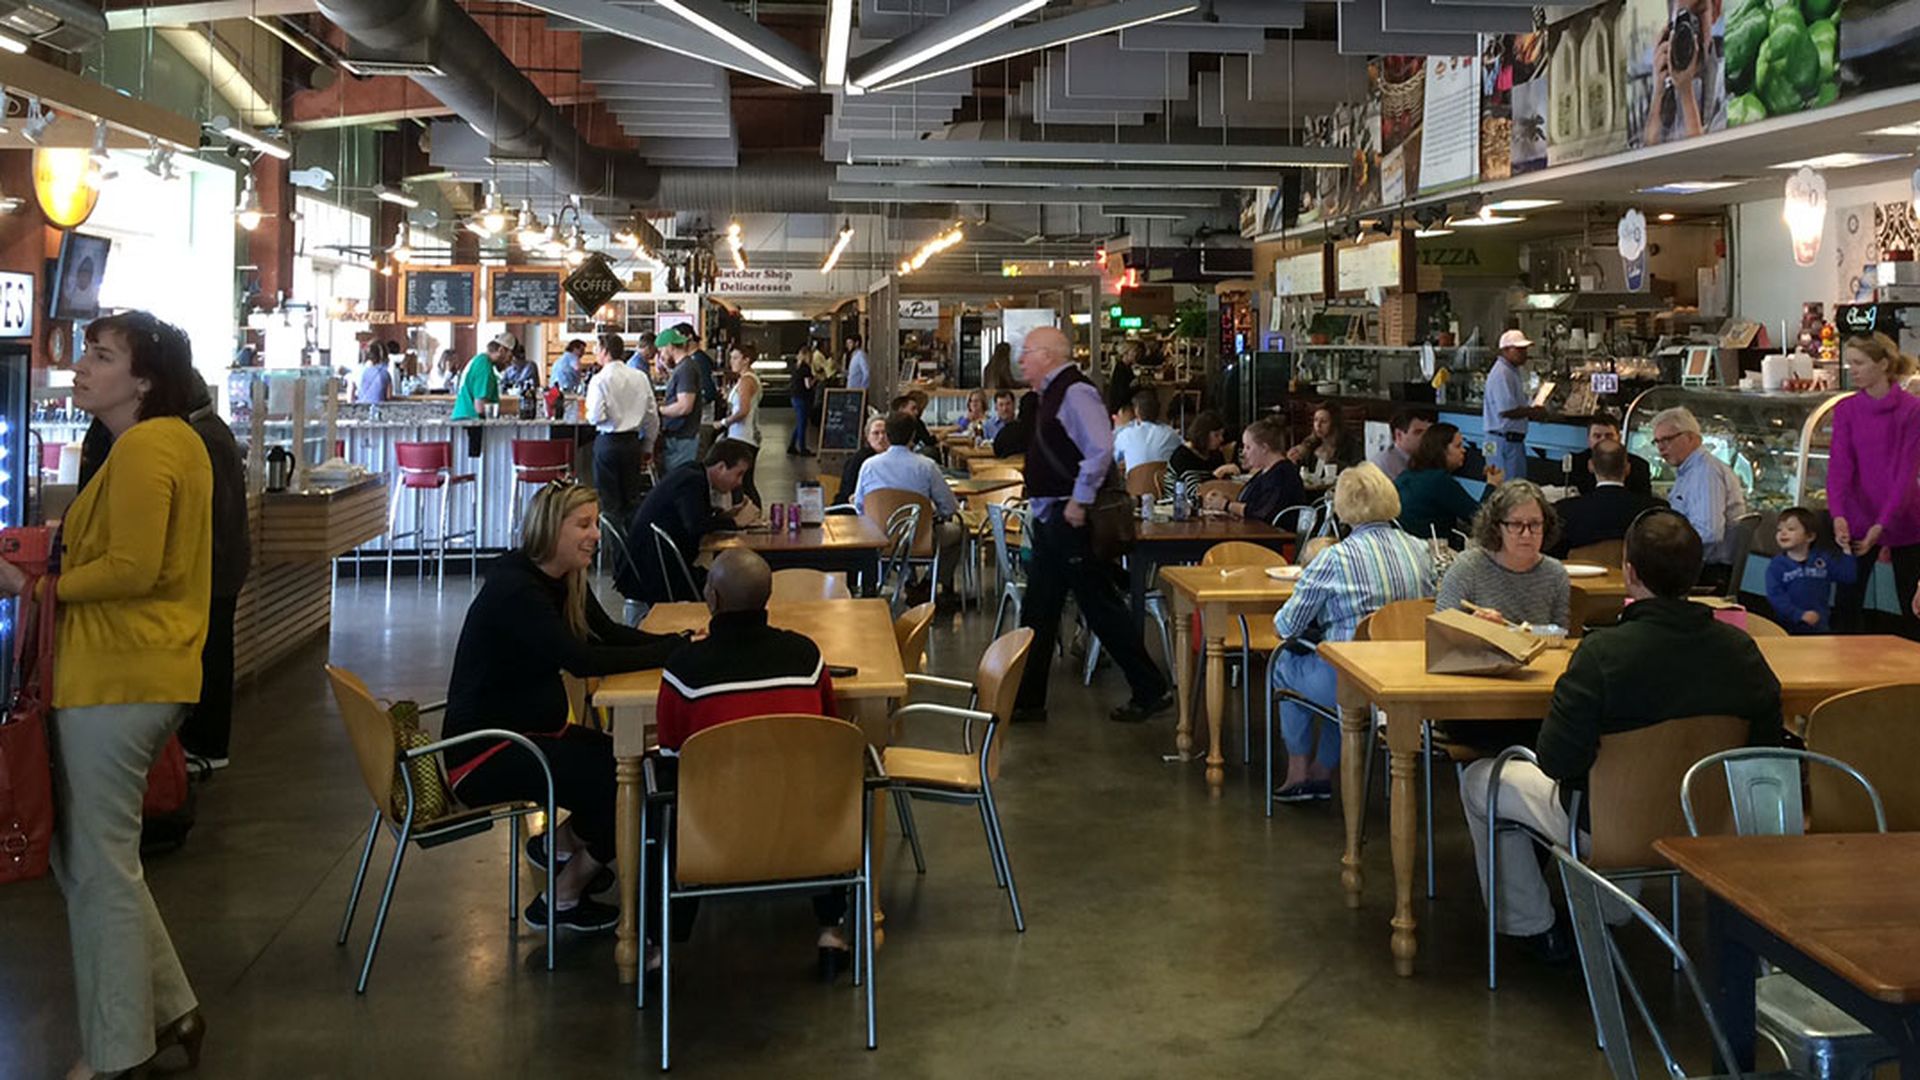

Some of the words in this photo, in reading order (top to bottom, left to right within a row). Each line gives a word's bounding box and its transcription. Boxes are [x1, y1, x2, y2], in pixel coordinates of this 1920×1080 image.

[1416, 248, 1480, 266] IZZA
[764, 269, 793, 280] Shop
[573, 279, 612, 291] COFFEE
[720, 282, 791, 291] Delicatessen
[0, 280, 25, 329] ES
[1593, 373, 1617, 391] OPEN
